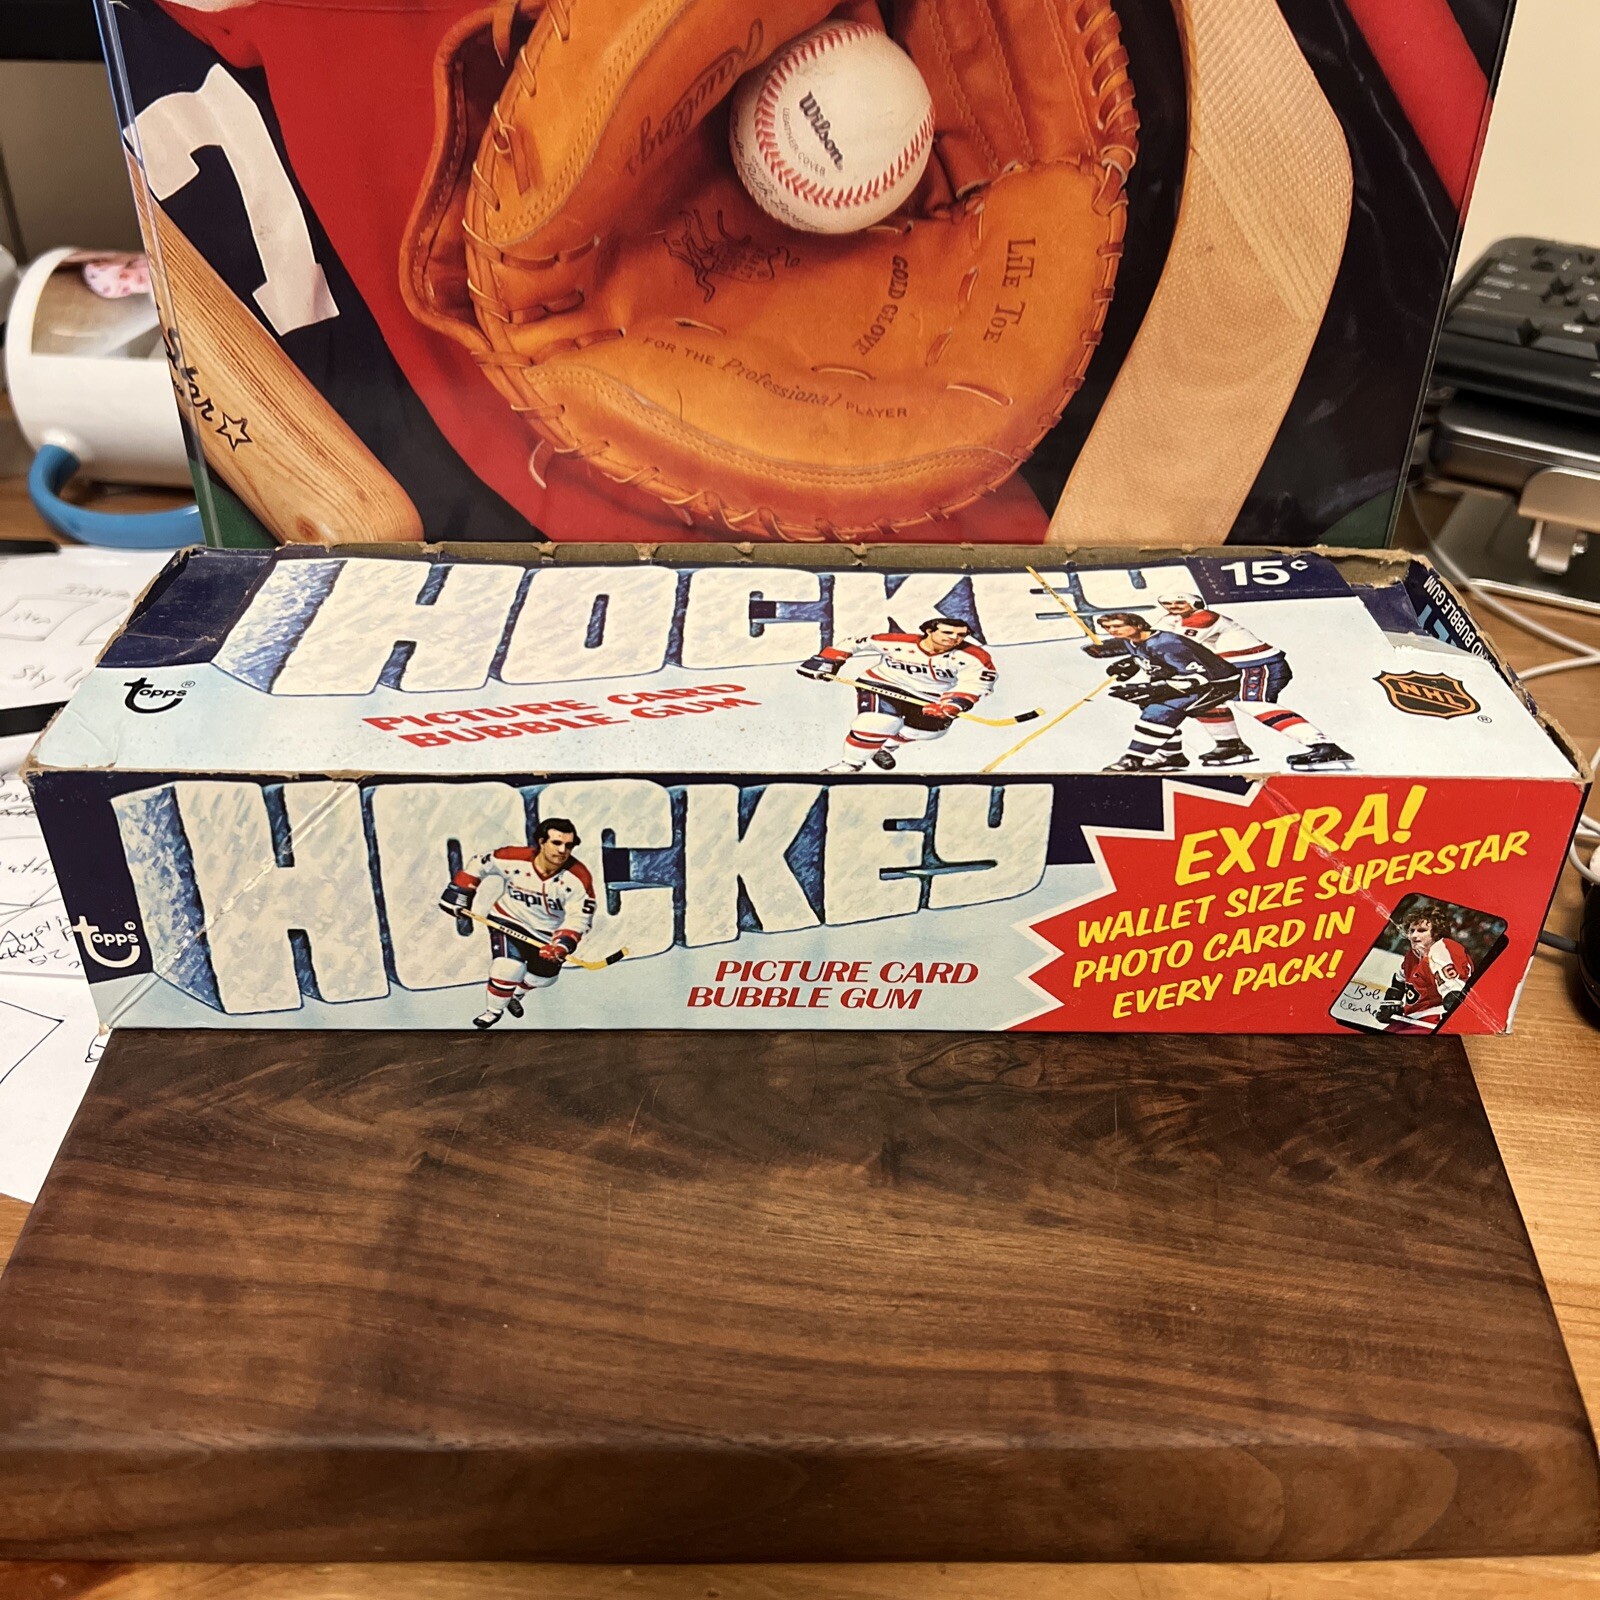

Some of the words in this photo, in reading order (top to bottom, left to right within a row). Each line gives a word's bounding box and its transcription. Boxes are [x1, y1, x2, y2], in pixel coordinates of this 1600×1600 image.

[625, 17, 764, 176] Rawlings
[782, 107, 799, 150] LEATHER
[798, 151, 827, 177] COVER
[799, 90, 843, 166] Wilson
[887, 254, 909, 300] GOLD
[854, 303, 899, 356] GLOVE
[642, 336, 677, 354] FOR
[684, 347, 715, 366] THE
[720, 357, 843, 408] Professional
[845, 401, 909, 419] PLAYER
[212, 556, 1195, 697] HOCKEY
[1423, 574, 1447, 606] GUM
[1440, 598, 1477, 648] BUBBLE
[123, 677, 187, 714] topps
[979, 670, 996, 682] 5
[1397, 680, 1467, 709] NHL
[361, 699, 598, 732] PICTURE
[606, 683, 747, 706] CARD
[398, 713, 630, 748] BUBBLE
[630, 698, 762, 719] GUM
[1174, 785, 1427, 887] EXTRA!
[110, 779, 1054, 1016] HOCKEY
[582, 898, 596, 915] 5
[1077, 894, 1220, 949] WALLET
[1223, 875, 1307, 918] SIZE
[1315, 829, 1531, 901] SUPERSTAR
[71, 915, 141, 968] topps
[1072, 938, 1194, 989] PHOTO
[1203, 914, 1305, 963] CARD
[1312, 906, 1357, 942] IN
[687, 986, 833, 1008] BUBBLE
[840, 987, 923, 1009] GUM
[714, 960, 872, 983] PICTURE
[879, 961, 979, 984] CARD
[1112, 974, 1223, 1020] EVERY
[1232, 948, 1344, 996] PACK!
[1434, 963, 1460, 986] 16
